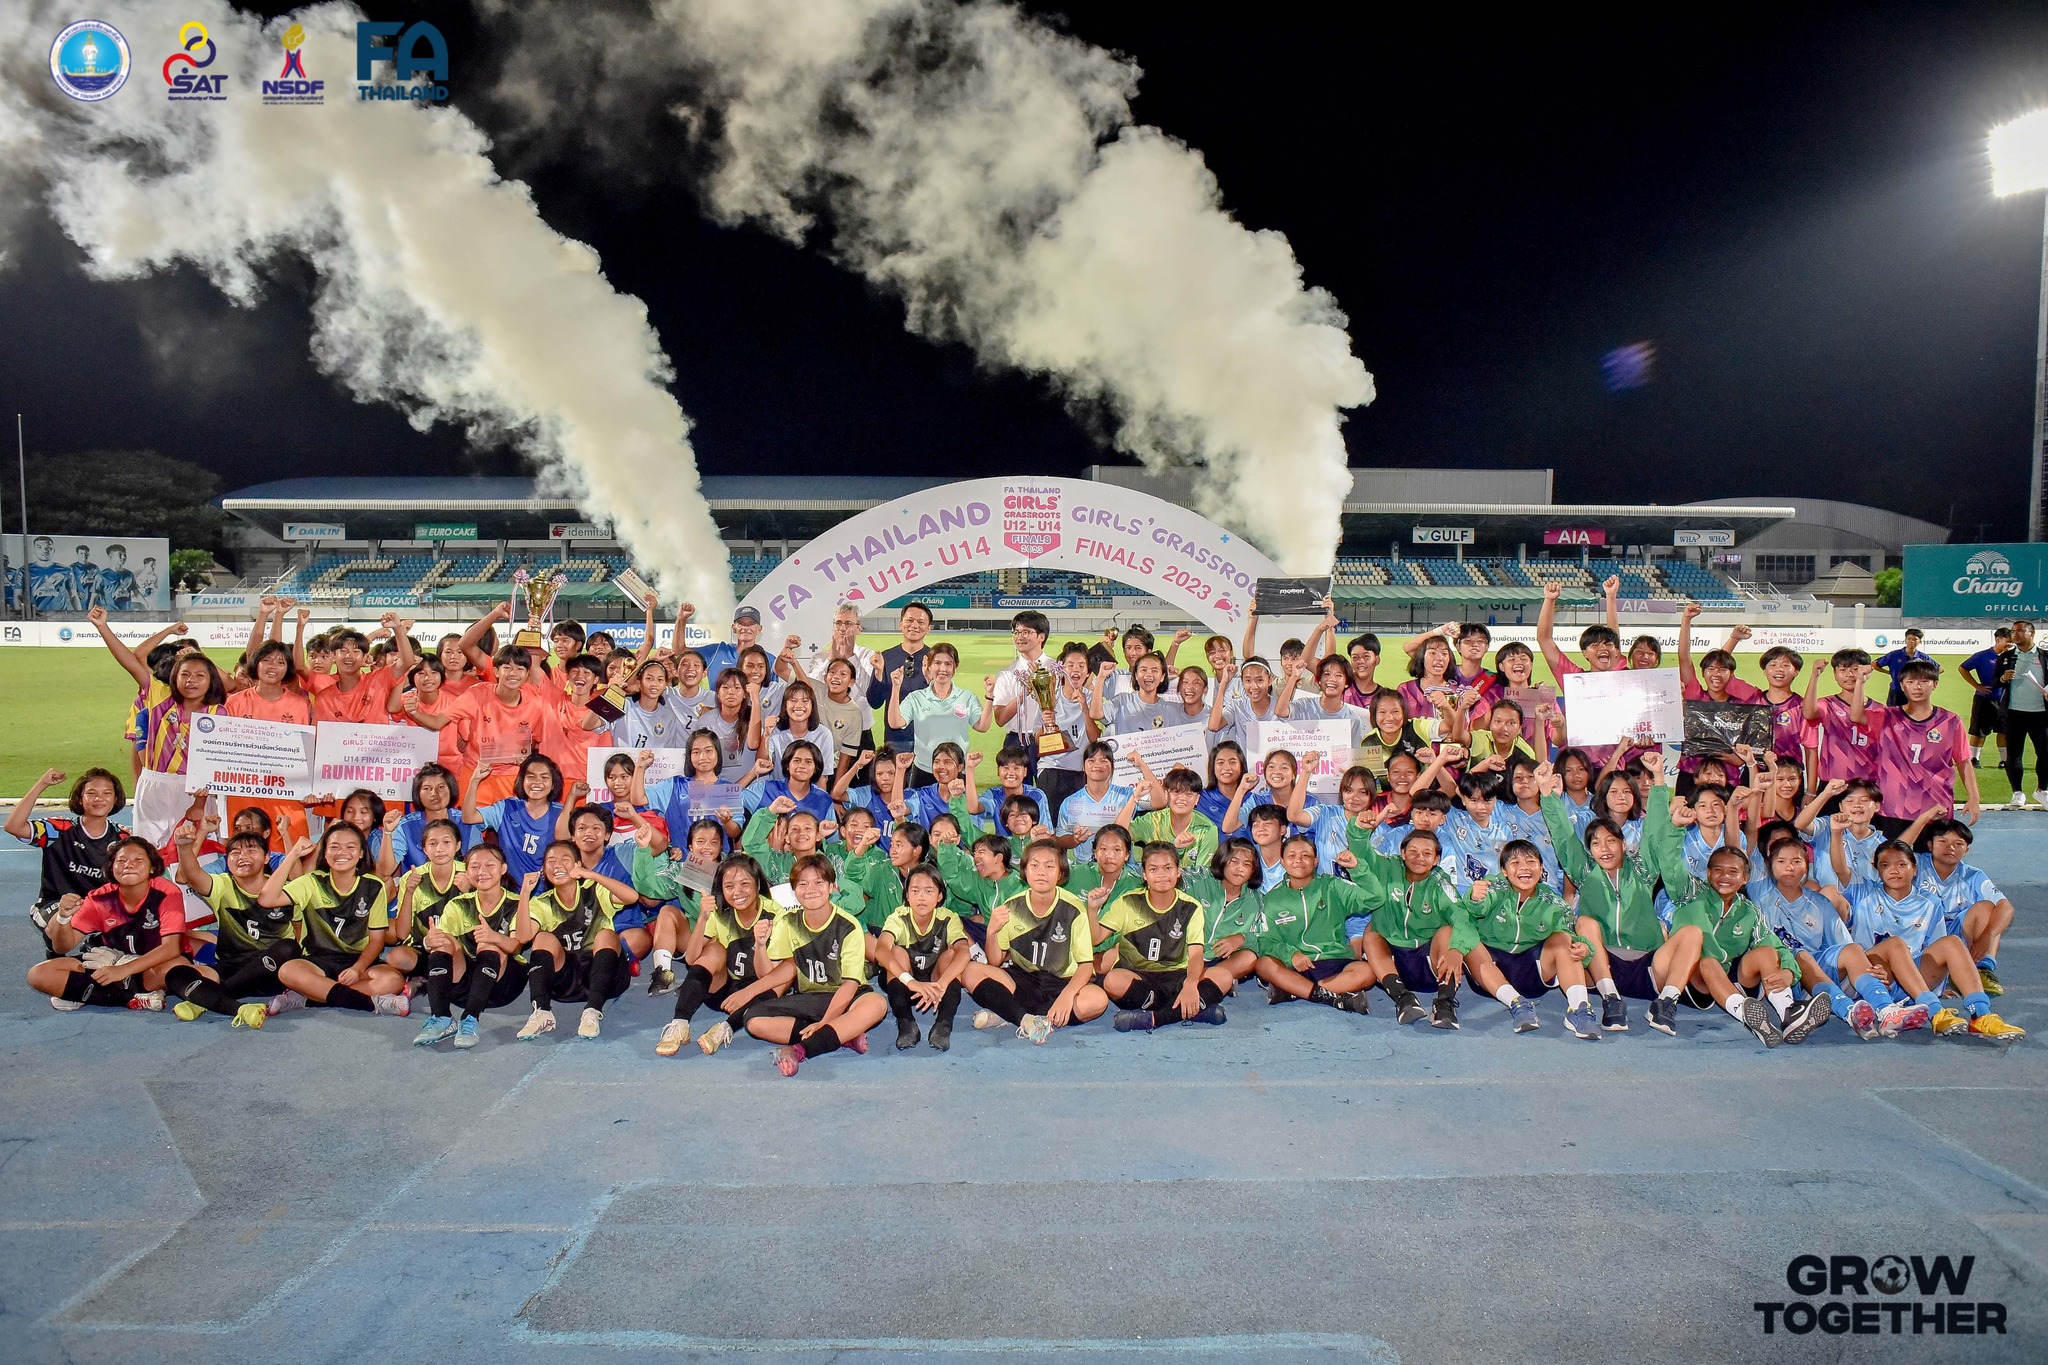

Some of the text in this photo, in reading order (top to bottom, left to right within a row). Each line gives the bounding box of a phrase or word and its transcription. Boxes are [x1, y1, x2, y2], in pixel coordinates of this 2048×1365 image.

[1004, 486, 1061, 495] FA THAILAND
[1003, 511, 1061, 519] GRASSROOTS
[568, 526, 610, 537] idemitsu
[1003, 520, 1027, 531] U12
[1038, 520, 1061, 531] U14
[298, 527, 341, 537] DAIKIN
[428, 527, 452, 537] EURO
[452, 527, 476, 538] CAKE
[1431, 530, 1468, 542] GULF
[1557, 530, 1591, 544] AIA
[1012, 535, 1051, 544] FINALS
[769, 502, 991, 621] FA THAILAND
[867, 558, 919, 594] U12
[938, 535, 991, 567] U14
[1075, 537, 1212, 600] FINALS 2023
[1953, 576, 2024, 598] Chang
[202, 596, 246, 606] DAIKIN
[365, 595, 392, 606] EURO
[392, 594, 417, 606] CAKE
[922, 597, 945, 606] Chang
[1621, 601, 1650, 612] AIA
[1985, 604, 2039, 612] OFFICIAL
[4, 626, 22, 639] FA
[209, 632, 231, 641] GIRLS
[605, 626, 644, 639] molte
[662, 627, 712, 639] mlten
[1777, 638, 1825, 646] GRASSROOTS
[1506, 689, 1520, 697] U14
[685, 715, 692, 731] 2
[241, 728, 283, 739] GRASSROOTS
[1288, 734, 1331, 742] GRASSROOTS
[368, 740, 416, 749] GRASSROOTS
[1121, 736, 1176, 749] GIRLS GRASSROOTS
[343, 755, 359, 763] U14
[361, 756, 391, 764] FINALS
[1910, 744, 1922, 764] 7
[214, 771, 286, 788] RUNNER-UPS
[240, 785, 274, 797] 20,000
[276, 787, 295, 797] บาท
[522, 832, 541, 855] 15
[688, 855, 704, 866] U14
[246, 920, 260, 940] 6
[333, 917, 346, 939] 7
[126, 935, 137, 954] 1
[563, 931, 584, 951] 15
[1031, 941, 1048, 967] 11
[1148, 938, 1162, 962] 8
[734, 952, 748, 977] 5
[805, 958, 828, 983] 10
